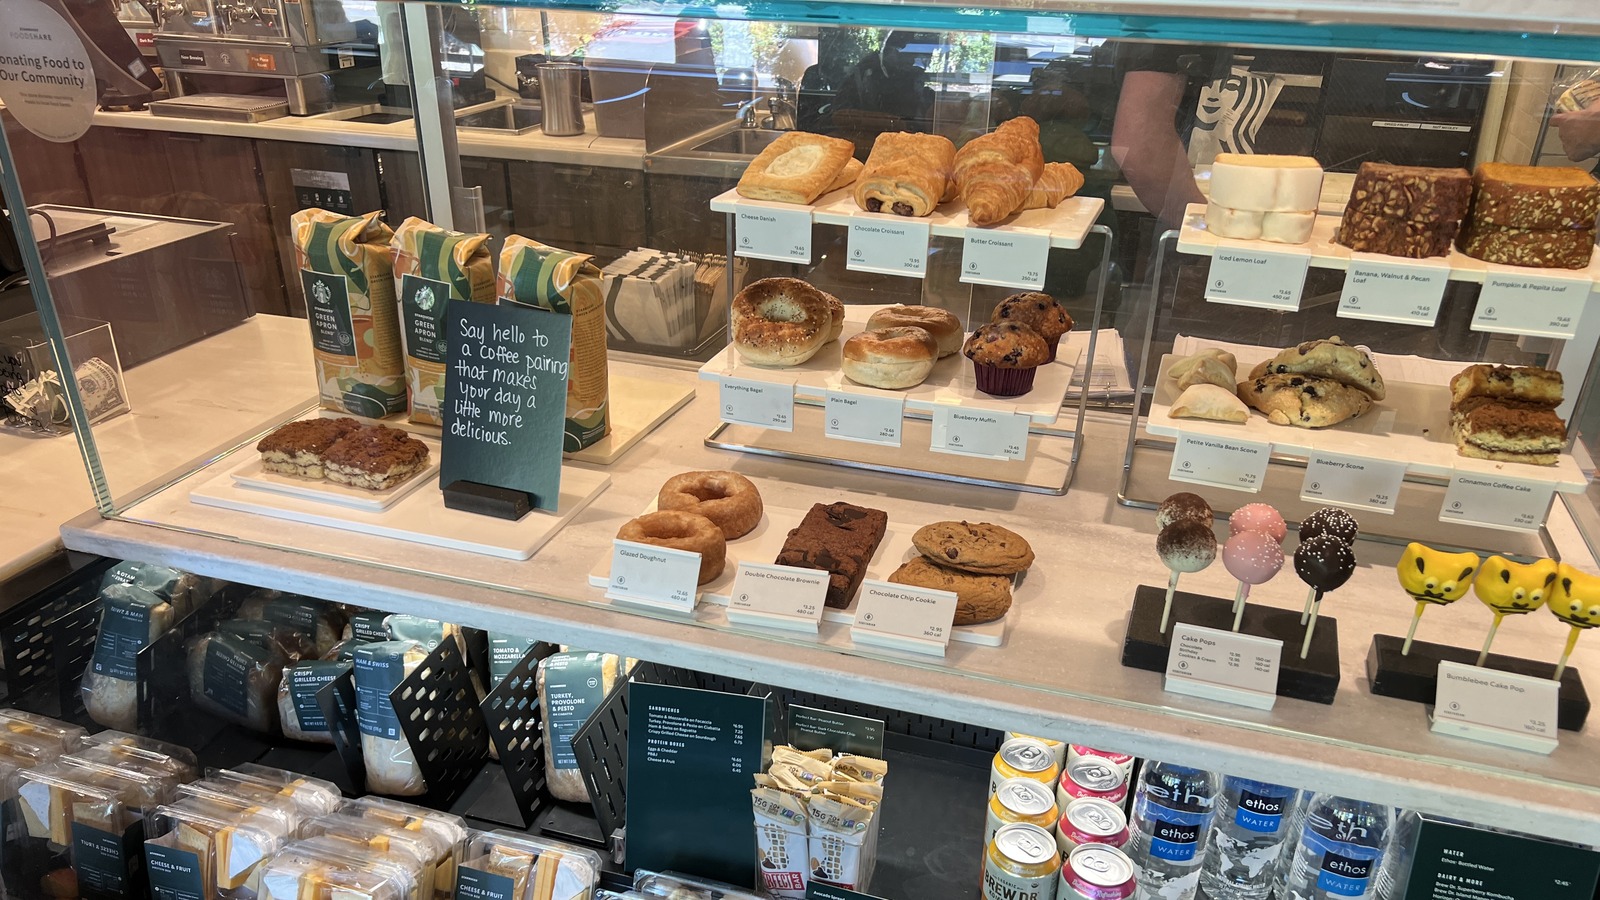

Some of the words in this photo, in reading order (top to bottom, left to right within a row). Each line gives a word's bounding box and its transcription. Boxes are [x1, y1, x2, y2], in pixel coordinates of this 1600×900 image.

[10, 32, 52, 40] FOODSHARE
[0, 54, 42, 70] onating
[42, 56, 69, 70] Food
[72, 58, 85, 70] to
[0, 70, 18, 80] Our
[22, 71, 84, 88] Community
[854, 225, 880, 234] Chocolate
[881, 228, 905, 236] Croissant
[988, 239, 1013, 247] Croissant
[1354, 270, 1380, 278] Banana,
[315, 312, 335, 322] GREEN
[316, 321, 337, 330] APRON
[414, 320, 435, 330] GREEN
[414, 328, 436, 338] APRON
[460, 318, 485, 344] Say
[492, 323, 525, 344] hello
[532, 329, 549, 347] to
[462, 344, 472, 356] a
[480, 345, 520, 364] coffee
[526, 354, 568, 380] pairing
[455, 360, 488, 381] that
[493, 368, 537, 390] makes
[724, 384, 750, 392] Everything
[460, 382, 491, 401] your
[495, 387, 521, 412] day
[527, 396, 536, 408] a
[489, 410, 523, 428] more
[954, 414, 978, 423] Blueberry
[451, 418, 512, 446] delicious.
[1316, 459, 1344, 468] Blueberry
[1459, 478, 1492, 487] Cinnamon
[1493, 482, 1514, 490] Coffee
[620, 550, 639, 558] Glazed
[640, 553, 667, 563] Doughnut
[766, 573, 795, 582] Chocolate
[869, 590, 899, 599] Chocolate
[915, 596, 936, 604] Cookie
[1182, 634, 1198, 642] Cake
[1199, 638, 1216, 646] Pops
[1447, 673, 1488, 686] Bumblebee
[1490, 681, 1508, 690] Cake
[1510, 685, 1524, 693] Pop
[648, 705, 680, 714] SANDWICHES
[754, 796, 767, 808] 15G
[1245, 798, 1279, 812] ethos
[812, 808, 826, 820] 15G
[1242, 817, 1274, 828] WATER
[1161, 828, 1195, 840] ethos
[1158, 846, 1190, 856] WATER
[1444, 849, 1464, 857] WATER
[150, 860, 170, 868] CHEESE
[1330, 860, 1367, 876] ethos
[1437, 872, 1457, 880] DAIRY
[985, 868, 1017, 900] BREW
[1326, 878, 1361, 891] WATER
[460, 884, 480, 894] CHEESE
[486, 890, 504, 899] FRUIT
